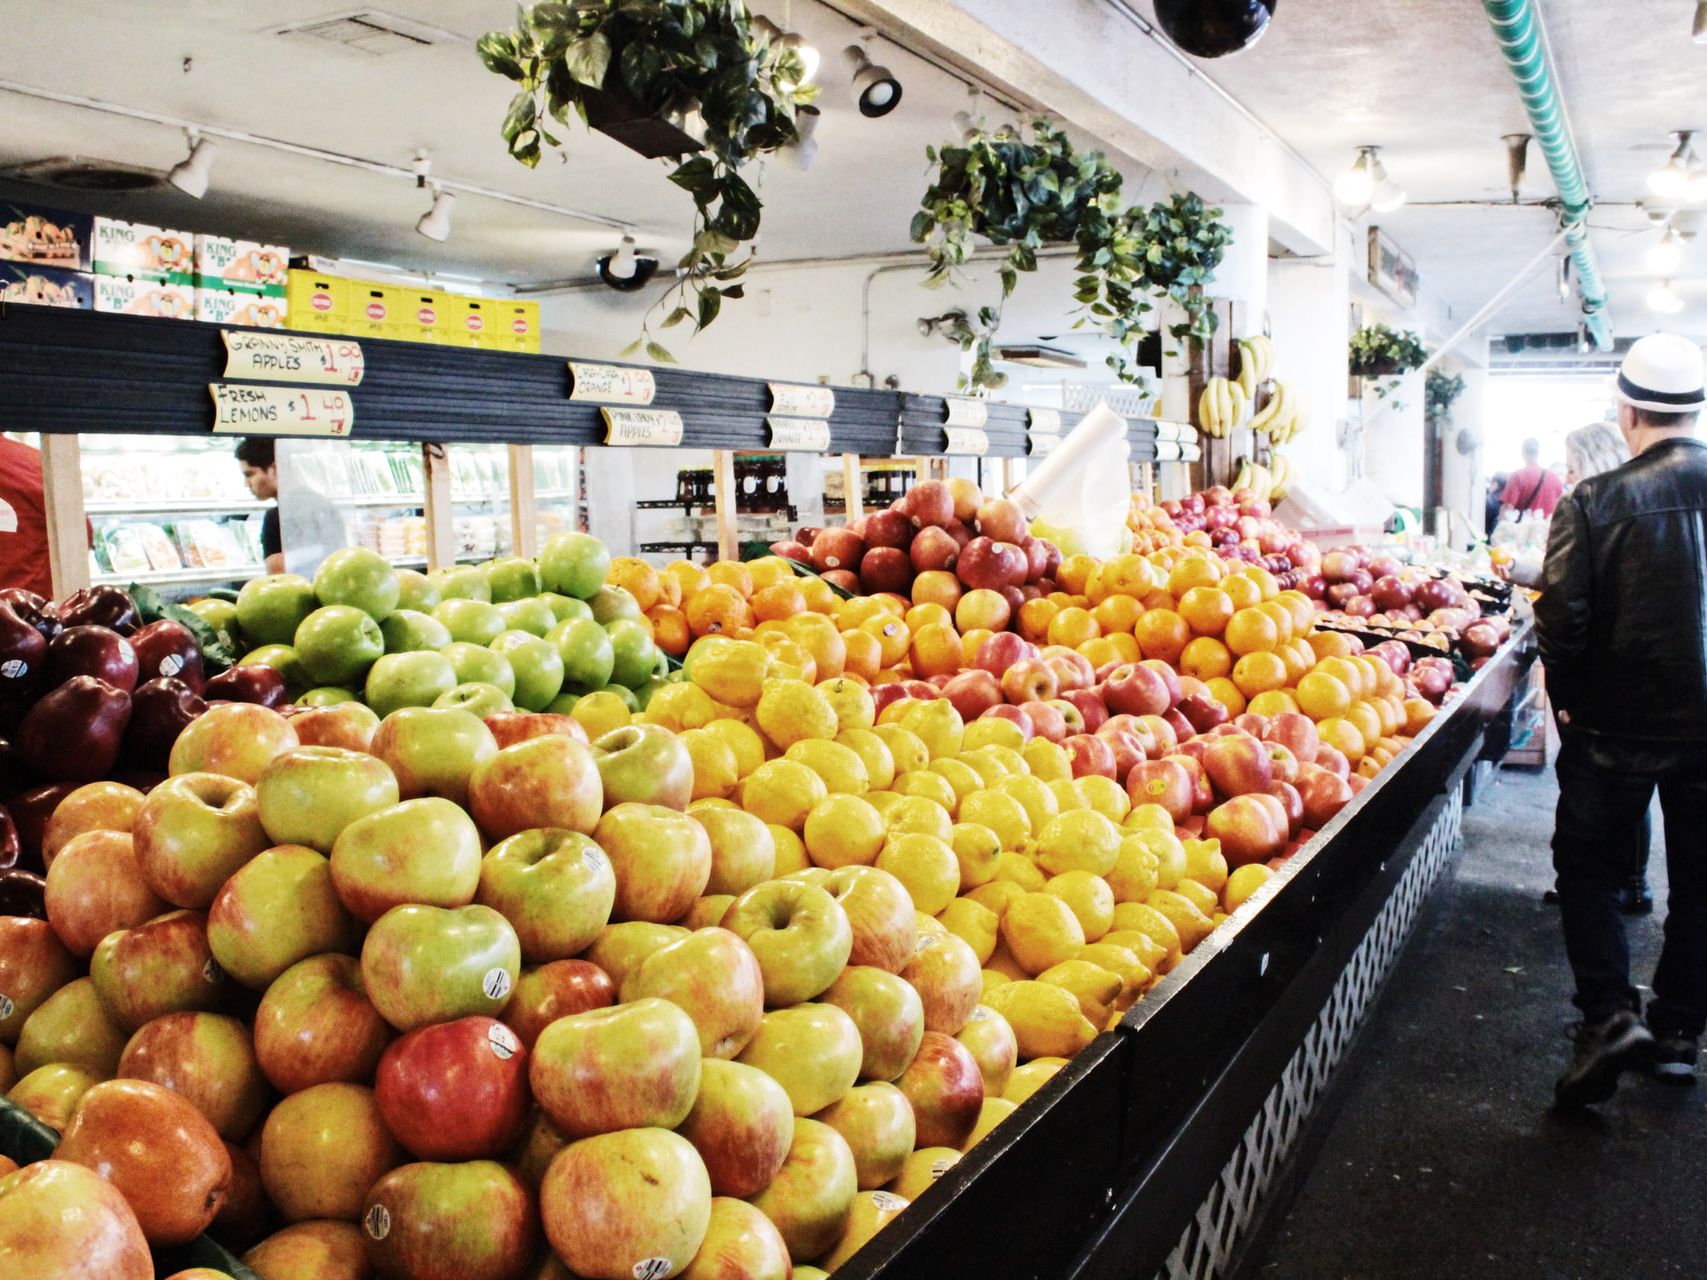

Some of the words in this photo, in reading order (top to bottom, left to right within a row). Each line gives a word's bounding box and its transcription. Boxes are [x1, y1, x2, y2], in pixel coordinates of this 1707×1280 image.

[100, 225, 134, 241] KING
[206, 241, 237, 258] KING
[100, 282, 134, 299] KING
[204, 297, 235, 312] KING
[252, 353, 301, 370] APPLES
[217, 384, 267, 403] FRESH
[220, 406, 278, 424] LEMONS
